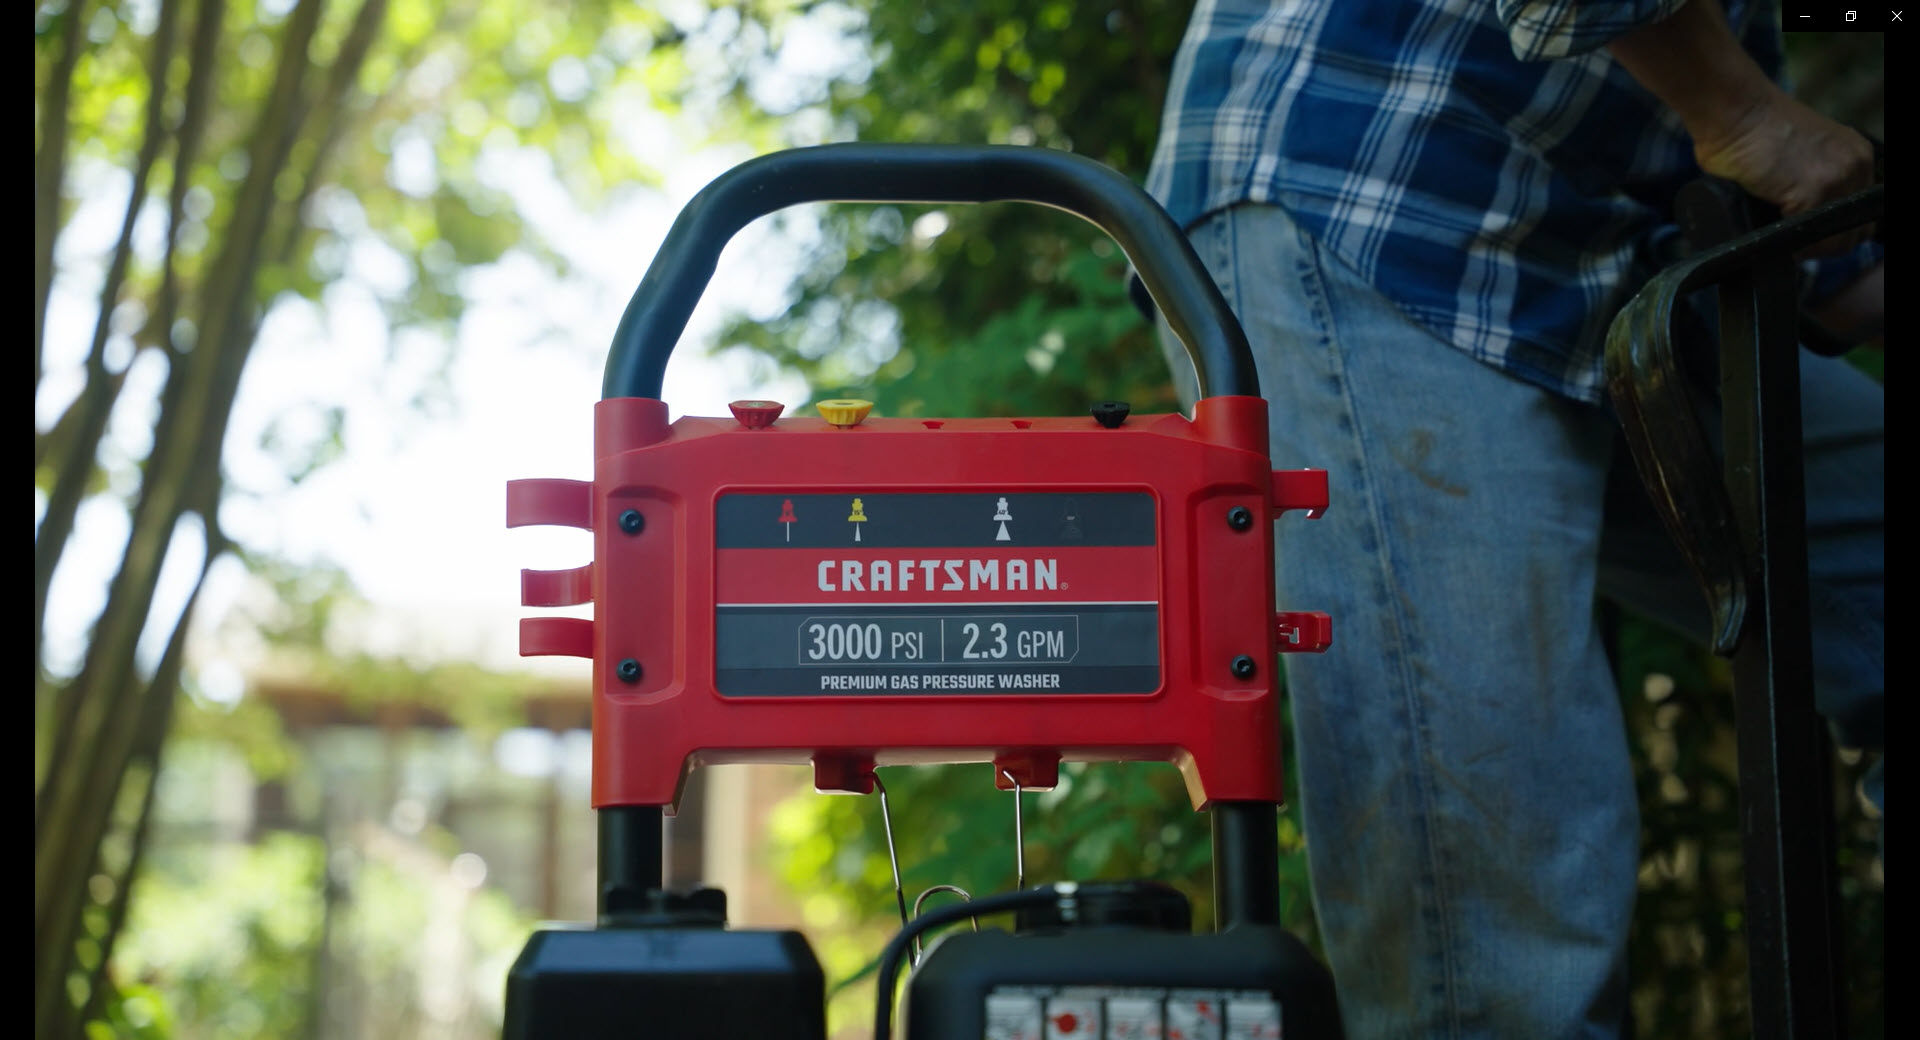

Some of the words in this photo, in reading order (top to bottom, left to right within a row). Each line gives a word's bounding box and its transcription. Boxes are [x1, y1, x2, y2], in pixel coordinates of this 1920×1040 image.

[808, 623, 882, 660] 3000
[891, 631, 924, 660] PSI
[962, 622, 1008, 659] 2.3
[1017, 630, 1064, 659] GPM
[820, 674, 887, 690] PREMIUM
[890, 674, 919, 690] GAS
[922, 673, 995, 689] PRESSURE
[997, 673, 1060, 689] WASHER
